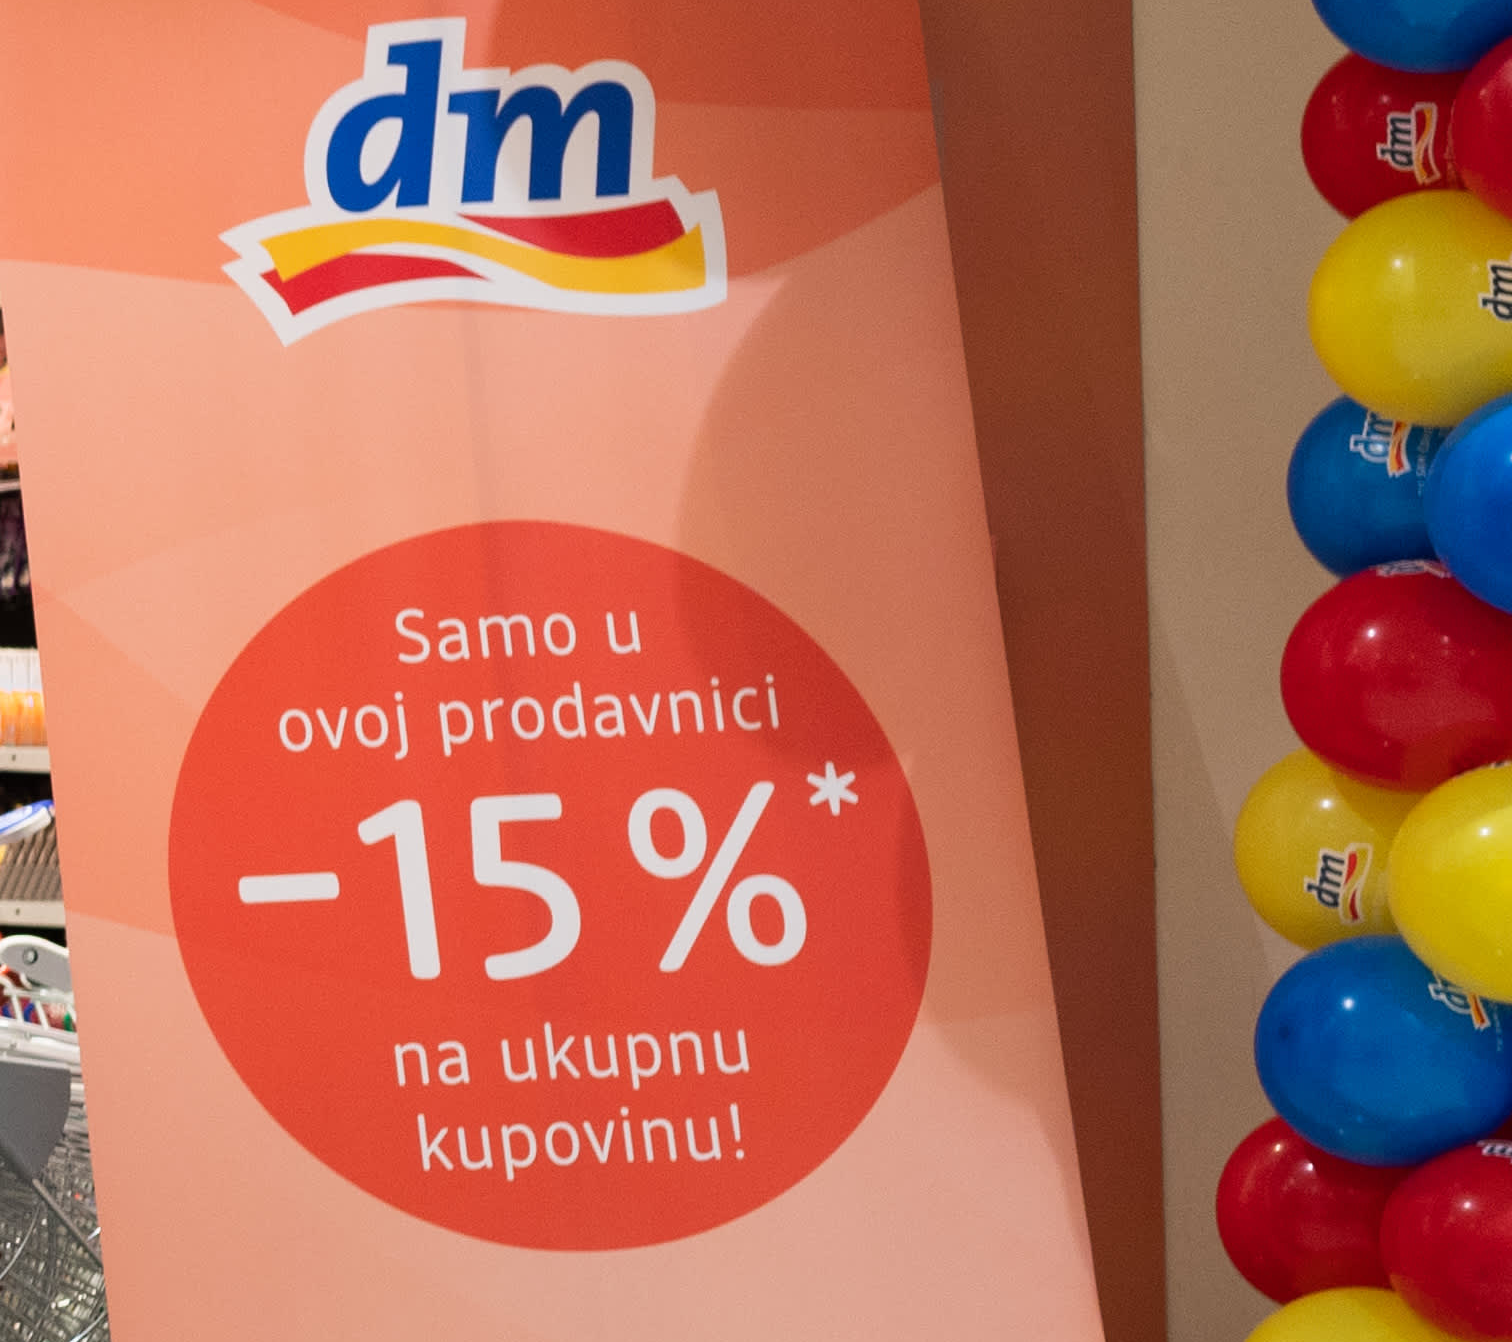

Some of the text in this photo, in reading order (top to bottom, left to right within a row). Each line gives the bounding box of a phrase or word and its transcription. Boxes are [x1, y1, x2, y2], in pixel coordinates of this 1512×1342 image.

[325, 39, 634, 214] dm
[1380, 116, 1413, 167] dm
[394, 607, 641, 664] Samo u
[278, 674, 780, 760] ovoj prodavnici
[1306, 853, 1344, 909] dm
[394, 1022, 751, 1091] na ukupnu
[417, 1103, 746, 1181] kupovinu!
